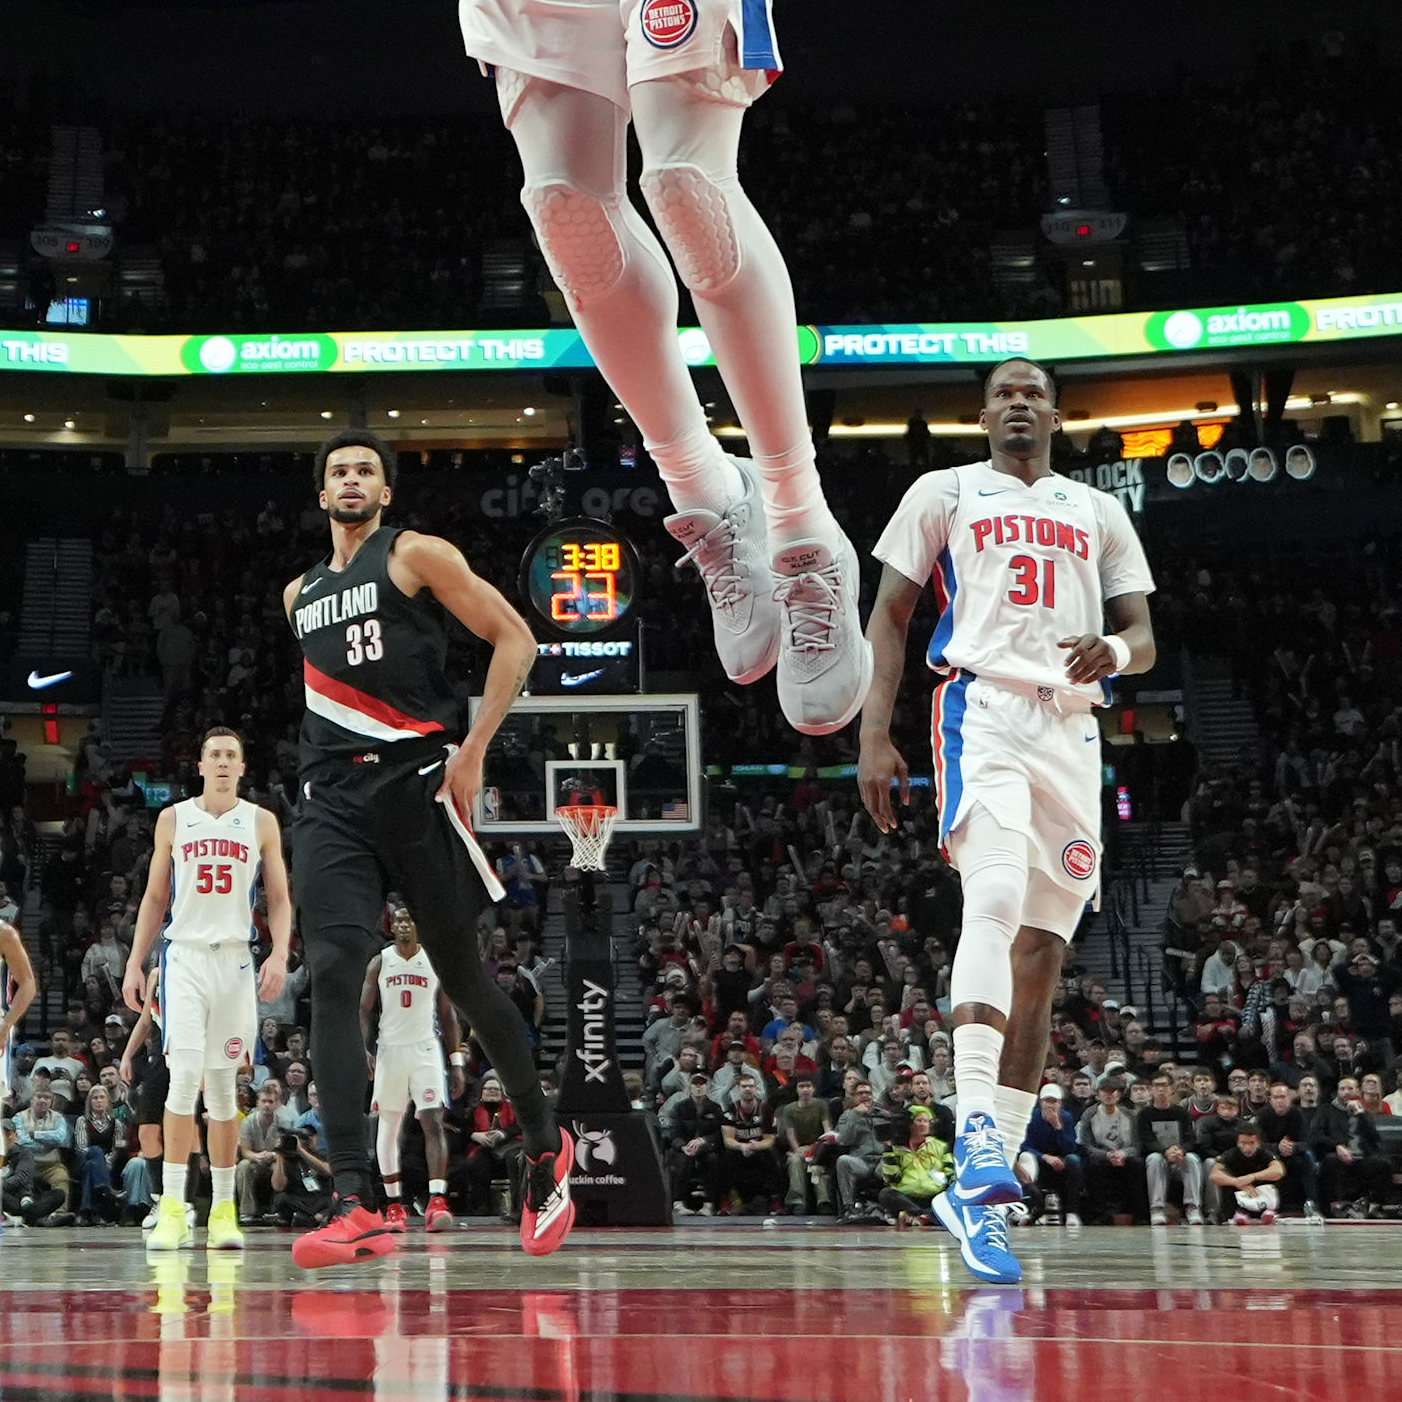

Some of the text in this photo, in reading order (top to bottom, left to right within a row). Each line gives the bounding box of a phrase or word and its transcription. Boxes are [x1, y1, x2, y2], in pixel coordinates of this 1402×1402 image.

[649, 4, 683, 19] DETROIT
[649, 15, 685, 30] PISTONS
[1208, 308, 1290, 333] axiom
[2, 341, 68, 362] THIS
[241, 336, 320, 360] axiom
[343, 339, 544, 363] PROTECT THIS
[825, 333, 1028, 355] PROTECT THIS
[284, 360, 318, 368] control
[970, 515, 1089, 560] PISTONS
[562, 544, 620, 571] 3:38
[1008, 554, 1054, 609] 31
[550, 572, 617, 621] 23
[296, 582, 378, 639] PORTLAND
[346, 619, 383, 666] 33
[561, 642, 632, 656] TISSOT
[181, 839, 248, 863] PISTONS
[197, 865, 232, 894] 55
[386, 974, 427, 988] PISTONS
[401, 990, 411, 1008] 0
[576, 979, 611, 1083] xfinity
[569, 1176, 624, 1184] uckin coffee
